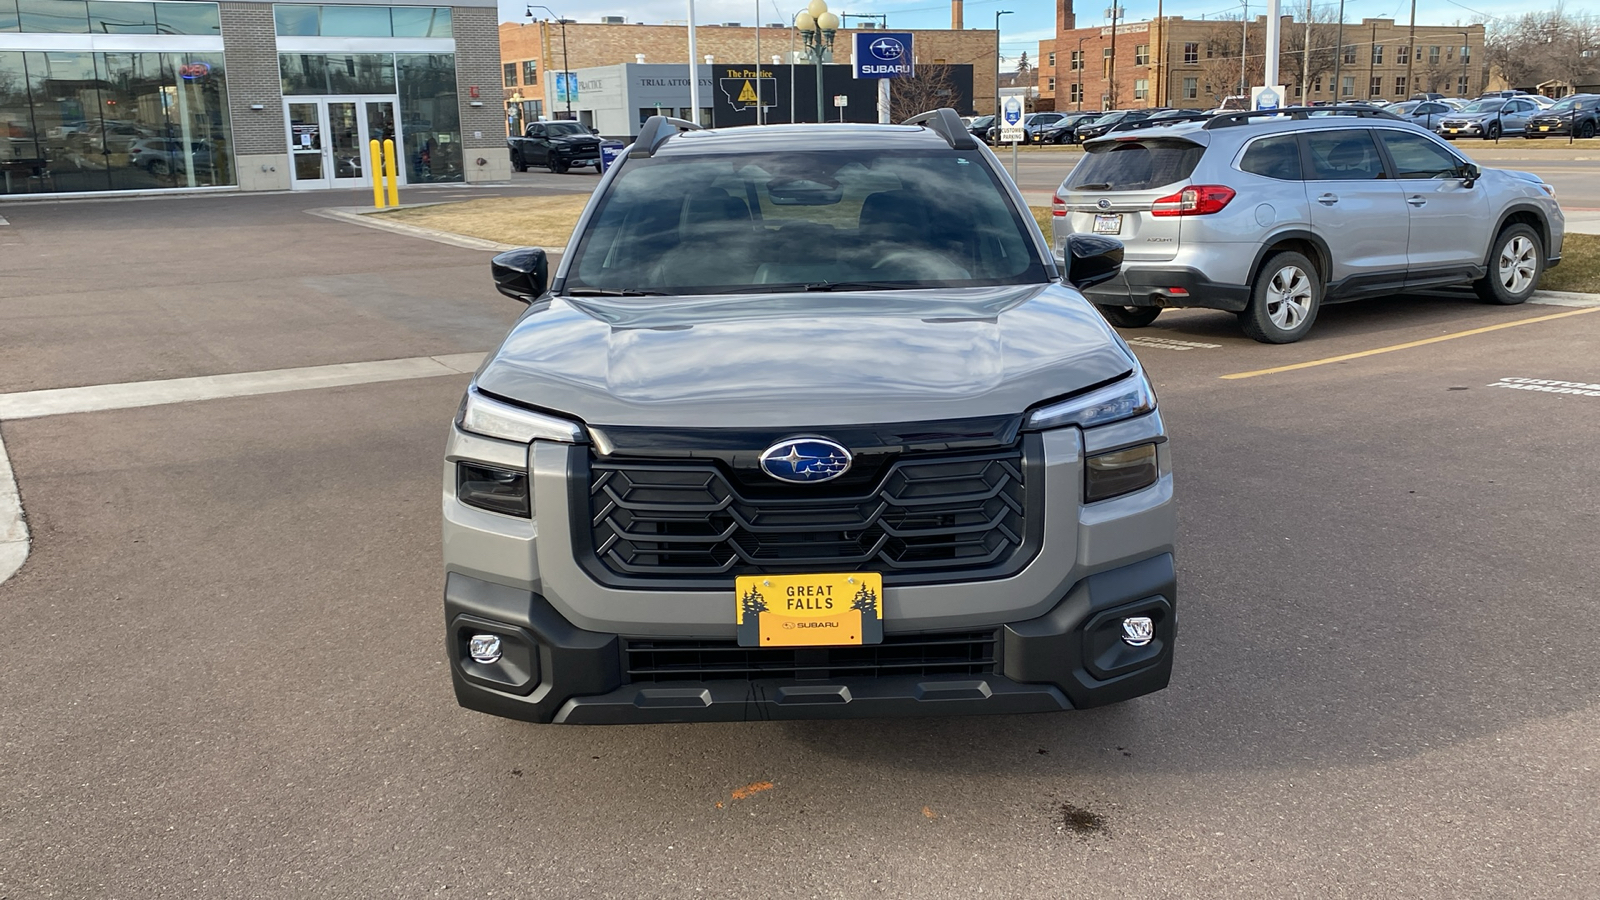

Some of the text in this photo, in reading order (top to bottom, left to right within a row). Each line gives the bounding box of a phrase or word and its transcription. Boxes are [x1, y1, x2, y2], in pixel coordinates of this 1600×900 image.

[727, 69, 773, 78] The Pratice
[861, 65, 910, 74] SUBARU
[578, 80, 602, 91] PRACTICE
[640, 79, 666, 87] TRIAL
[786, 585, 833, 597] GREAT
[787, 598, 833, 610] FALLS
